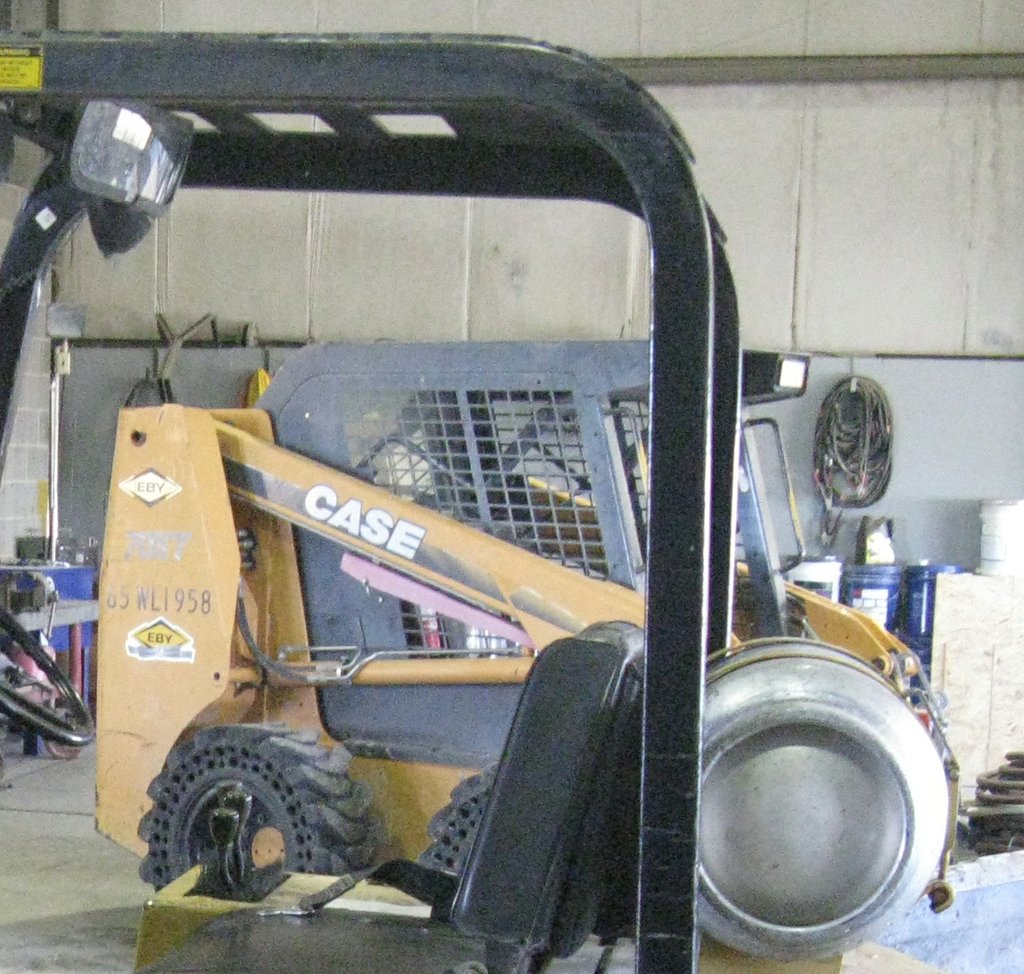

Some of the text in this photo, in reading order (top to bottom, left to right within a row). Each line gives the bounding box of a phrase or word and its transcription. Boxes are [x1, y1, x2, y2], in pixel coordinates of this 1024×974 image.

[137, 481, 166, 493] EBY
[304, 484, 426, 561] CASE
[147, 632, 174, 644] EBY
